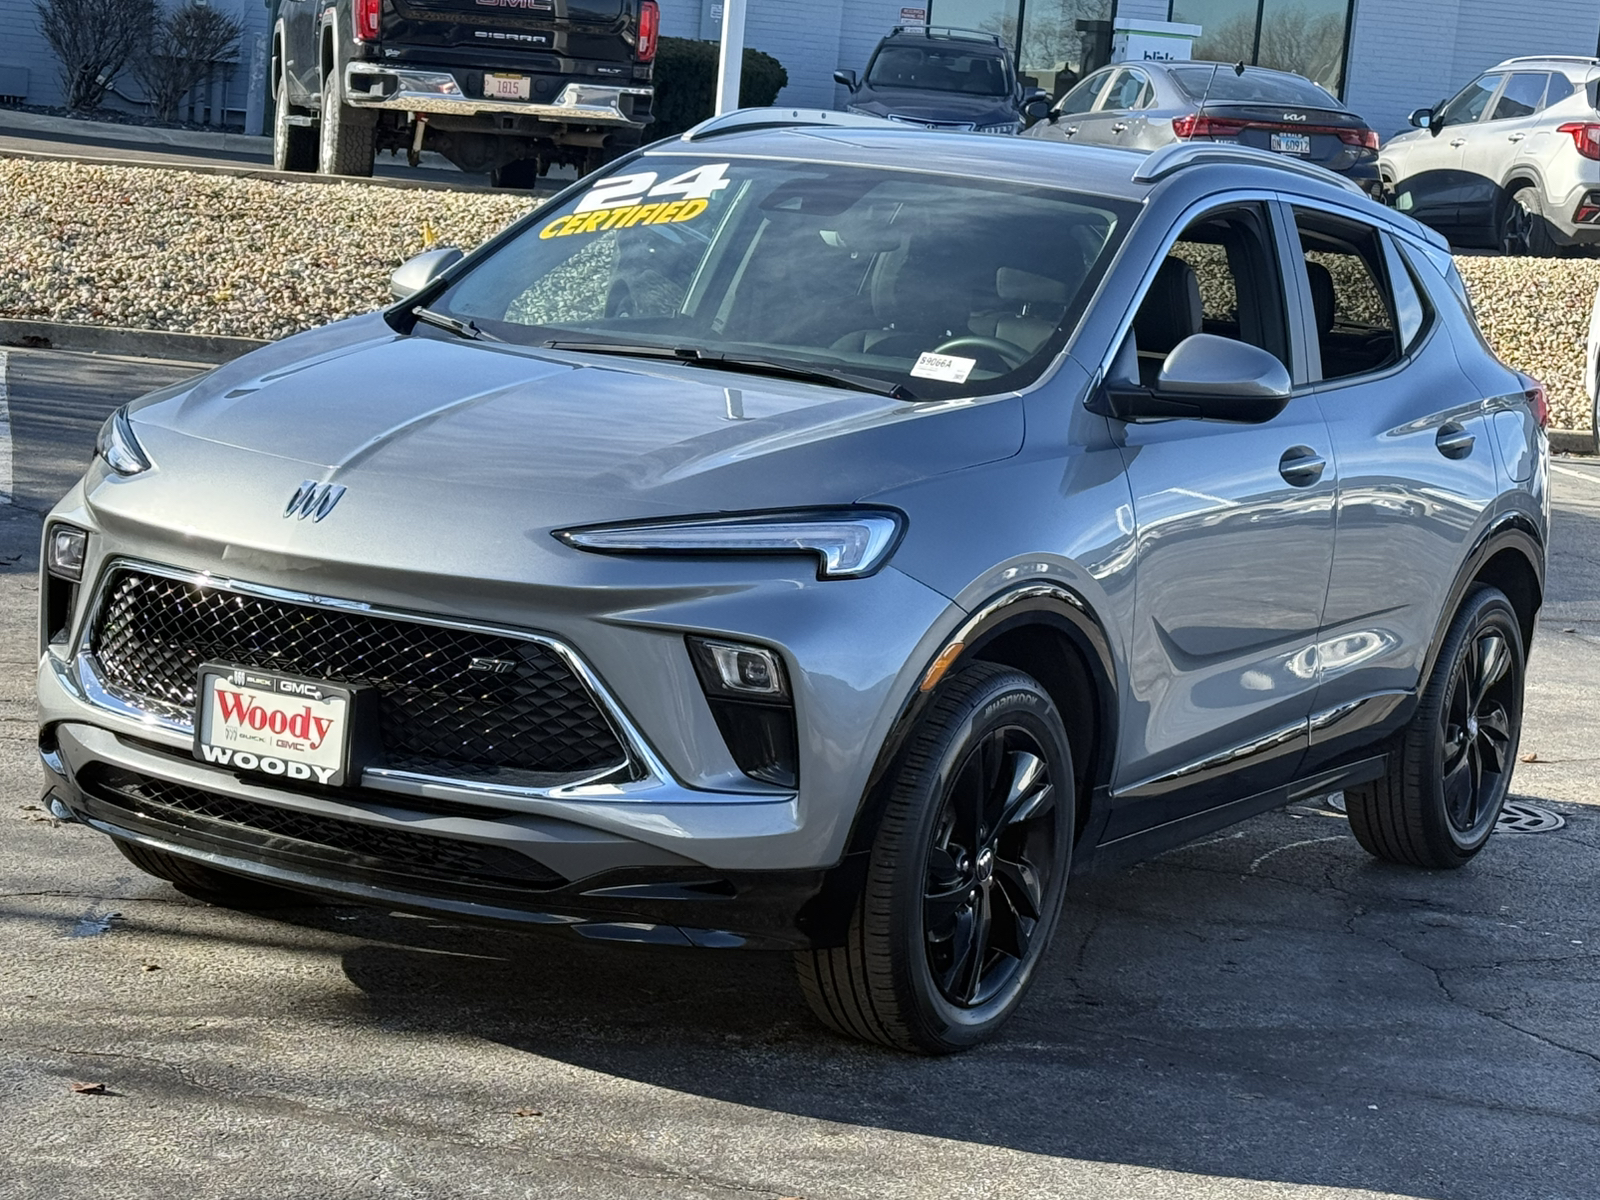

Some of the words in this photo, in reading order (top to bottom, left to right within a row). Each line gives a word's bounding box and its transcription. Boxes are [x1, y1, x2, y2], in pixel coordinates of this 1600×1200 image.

[474, 31, 546, 43] SIERRA
[497, 80, 519, 95] 1815
[1283, 113, 1306, 121] KIA
[573, 163, 731, 214] 24
[538, 198, 709, 240] CERTIFIED
[469, 657, 516, 674] ST
[246, 676, 272, 687] BUICK
[280, 680, 317, 697] GMC
[214, 688, 335, 751] Woody
[239, 733, 265, 744] BUICK
[275, 739, 305, 753] GMC
[201, 744, 336, 784] WOODY
